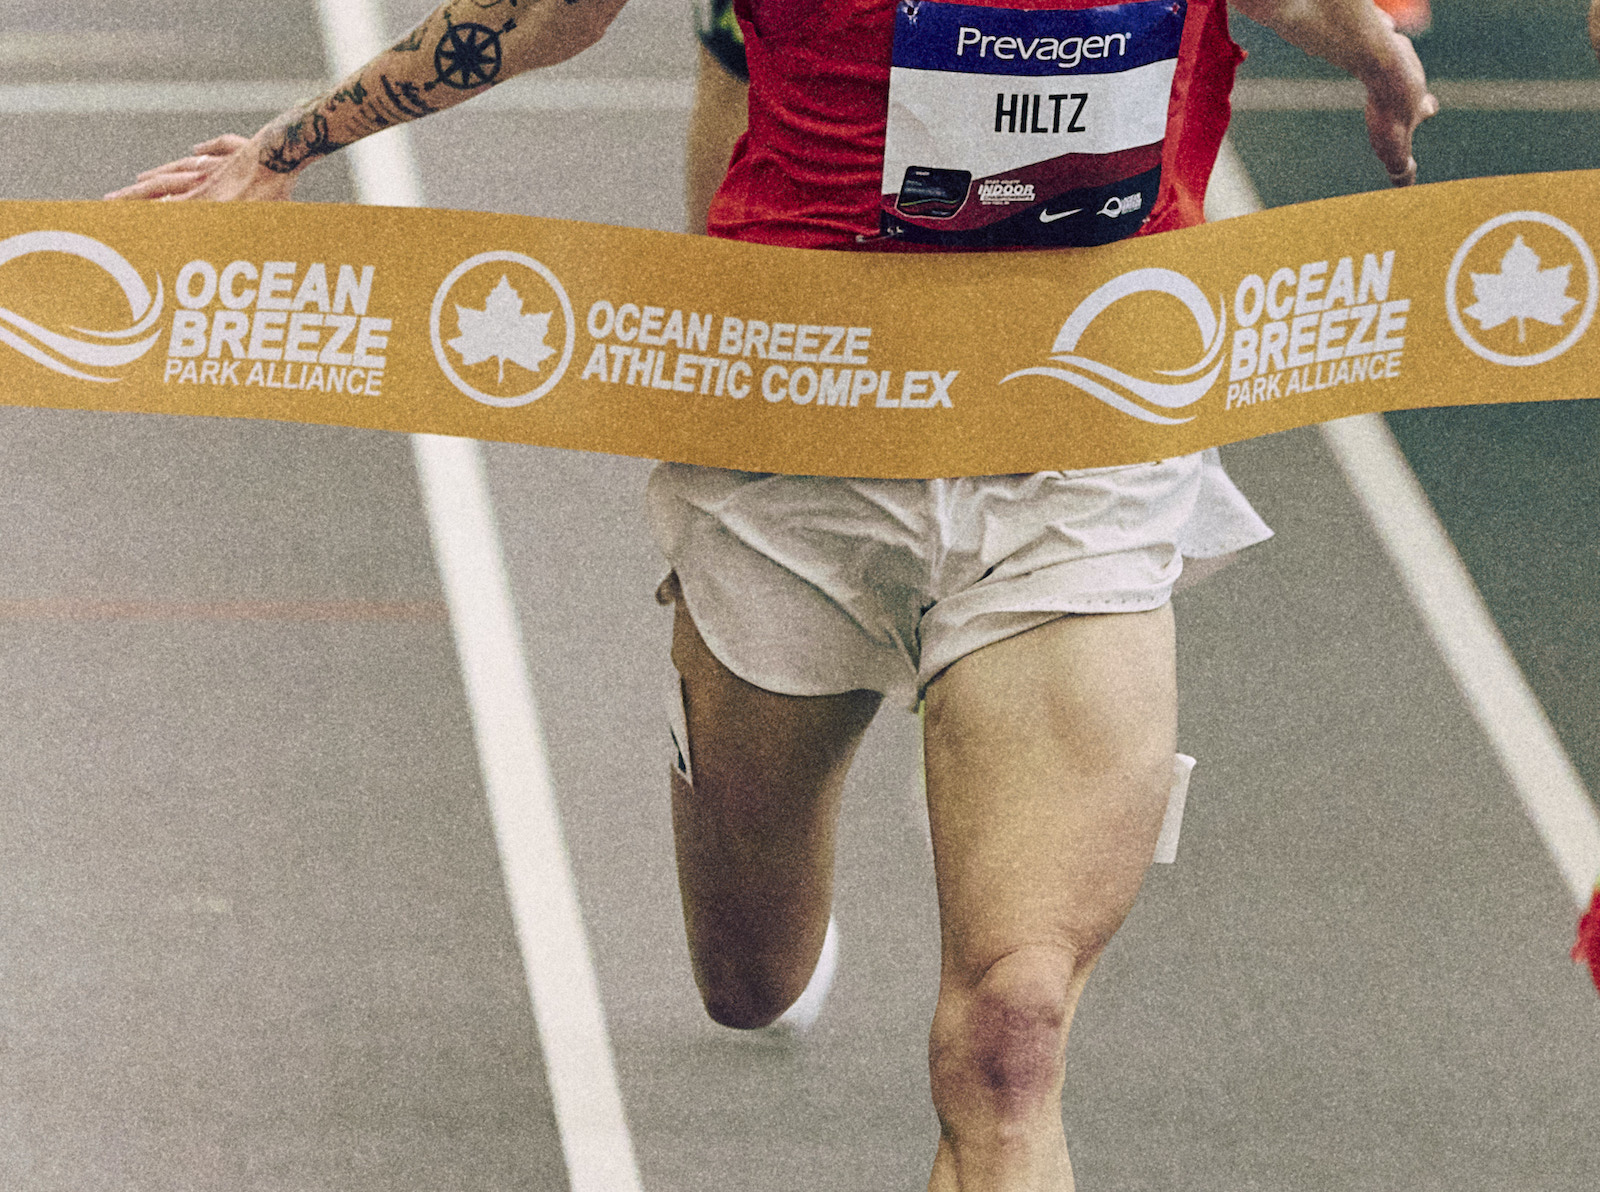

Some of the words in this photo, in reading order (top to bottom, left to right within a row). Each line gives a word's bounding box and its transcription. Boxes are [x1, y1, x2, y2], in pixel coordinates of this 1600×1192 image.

[956, 26, 1128, 68] Prevagen
[994, 93, 1089, 134] HILTZ
[978, 184, 1035, 195] INDOOR
[175, 260, 375, 314] OCEAN
[1234, 250, 1395, 327] OCEAN
[168, 309, 392, 368] BREEZE
[587, 300, 714, 351] OCEAN
[719, 318, 871, 364] BREEZE
[1229, 299, 1410, 382] BREEZE
[164, 359, 239, 385] PARK
[246, 361, 383, 396] ALLIANCE
[582, 344, 751, 399] ATHLETIC
[761, 365, 959, 408] COMPLEX
[1226, 371, 1281, 410] PARK
[1284, 351, 1404, 397] ALLIANCE
